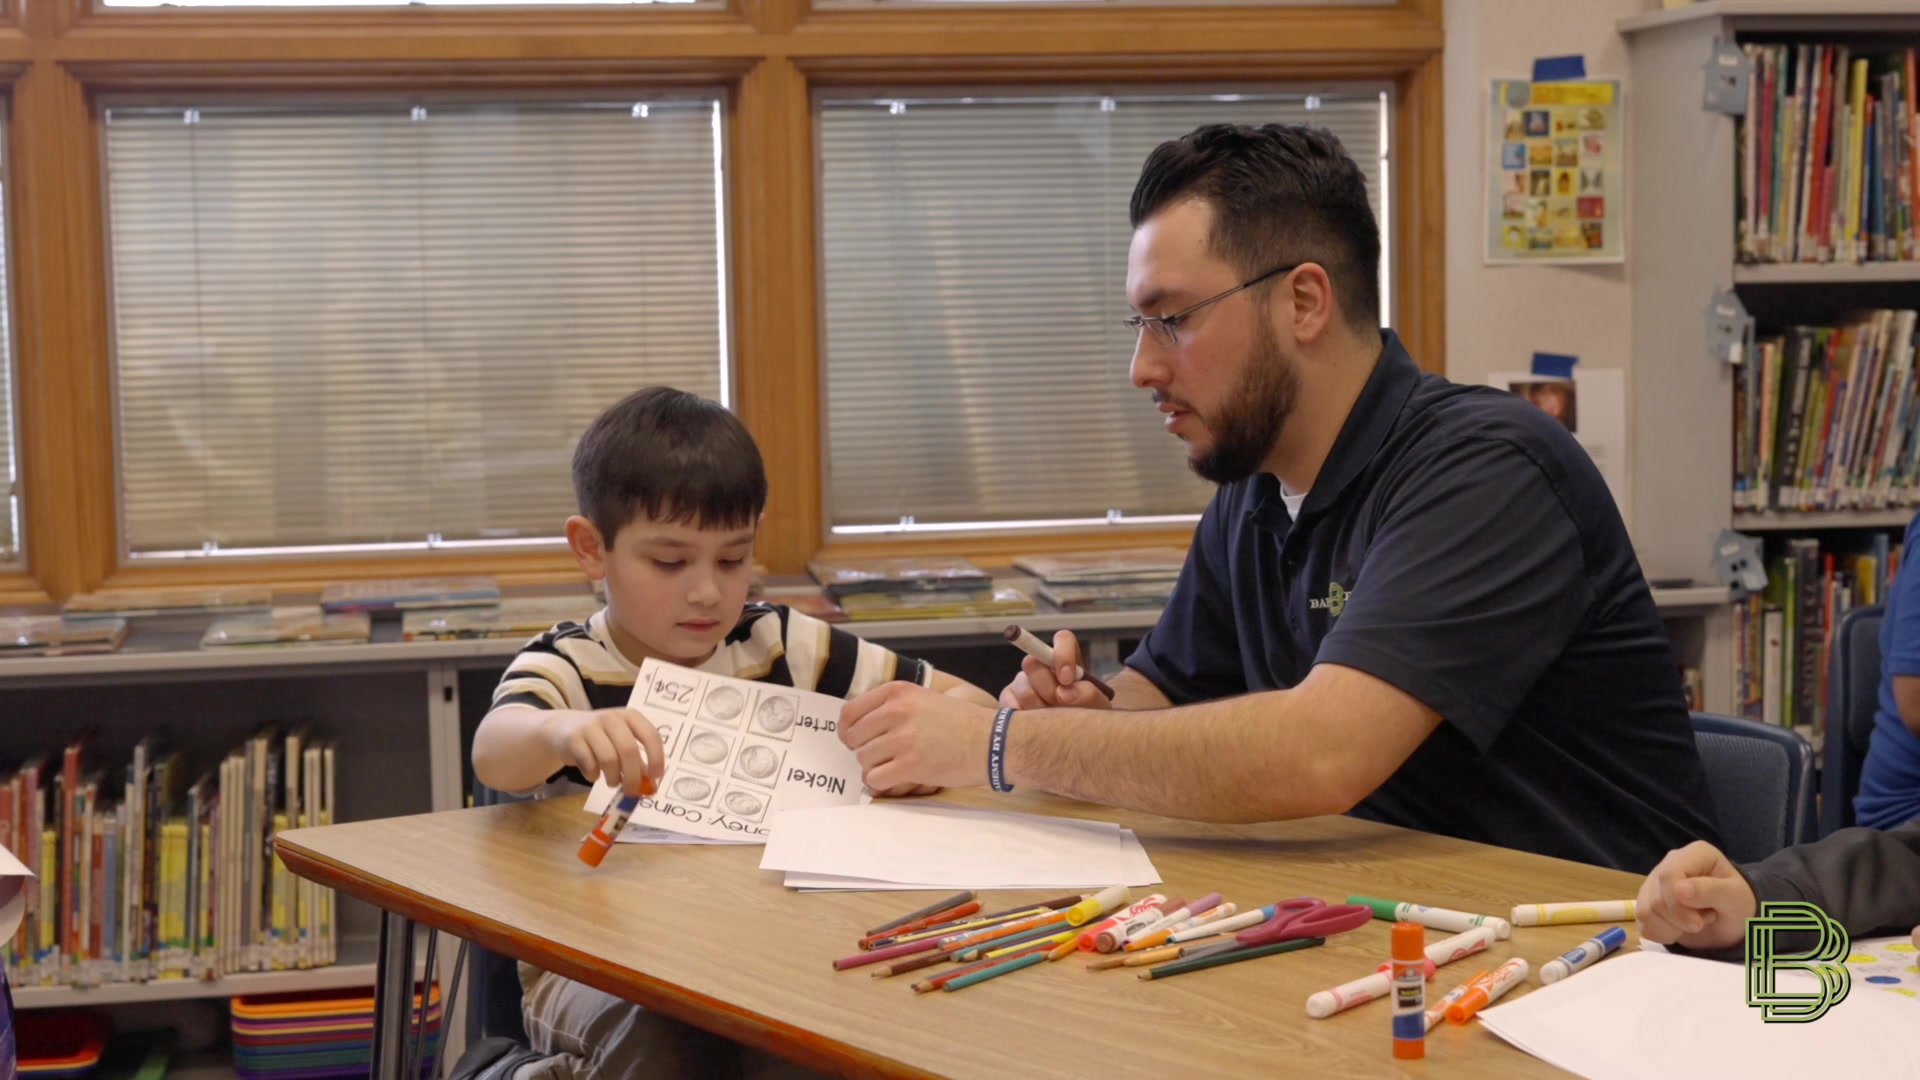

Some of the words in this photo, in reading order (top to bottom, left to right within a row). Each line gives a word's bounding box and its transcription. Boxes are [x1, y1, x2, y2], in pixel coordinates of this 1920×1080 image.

[655, 680, 695, 703] 25¢
[796, 715, 837, 732] arter
[993, 735, 1001, 751] BY
[787, 768, 846, 795] Nickel
[640, 797, 702, 822] Coins
[708, 814, 771, 836] oney:
